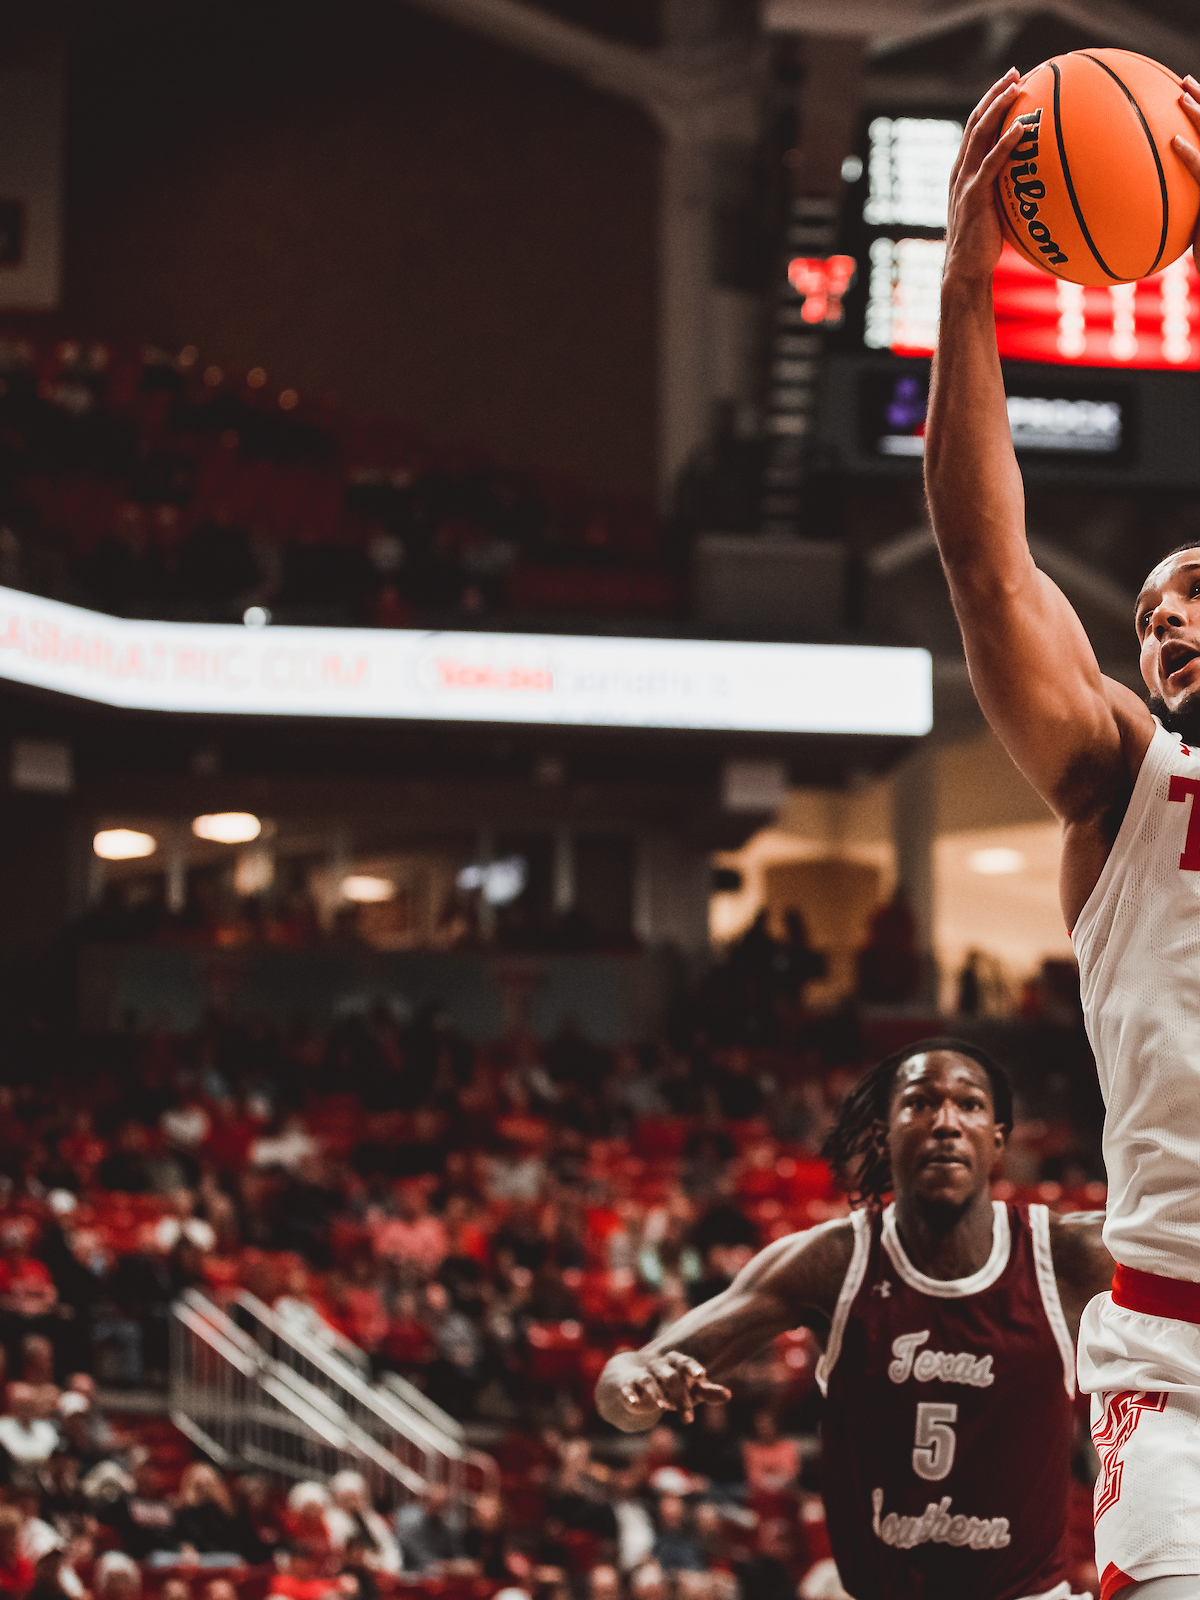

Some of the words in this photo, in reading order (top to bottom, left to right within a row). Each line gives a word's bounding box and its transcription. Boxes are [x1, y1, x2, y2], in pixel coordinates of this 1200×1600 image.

[1010, 108, 1068, 265] Wilson
[888, 1330, 995, 1388] Texas
[912, 1402, 958, 1481] 5
